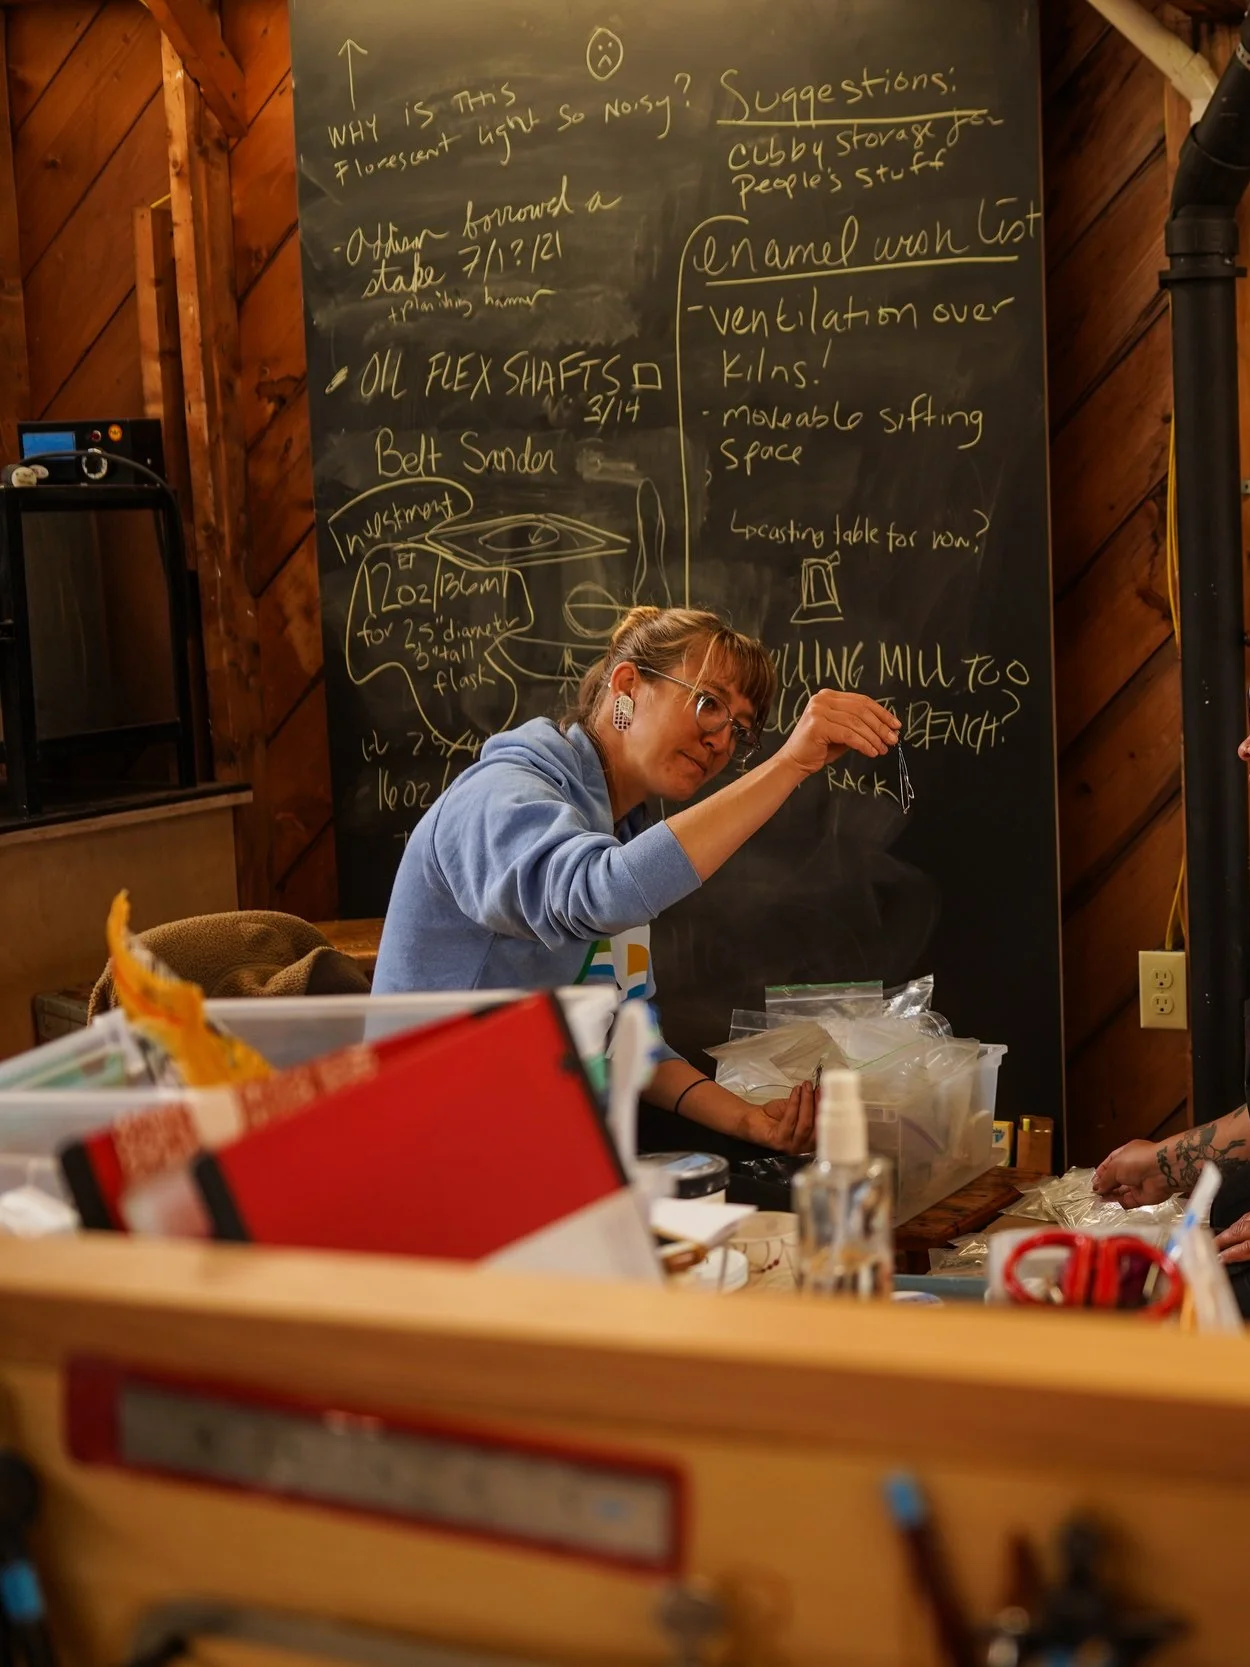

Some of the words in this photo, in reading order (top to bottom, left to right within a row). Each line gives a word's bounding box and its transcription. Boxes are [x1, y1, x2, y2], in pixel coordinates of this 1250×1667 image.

[719, 67, 957, 129] Suggestions:
[328, 114, 378, 149] WHY
[587, 190, 623, 211] a
[693, 214, 860, 276] enamel
[872, 220, 971, 264] wish
[931, 296, 1016, 324] over
[425, 351, 492, 401] FLEX
[503, 350, 622, 397] SHAFTS
[722, 400, 864, 431] moveable
[879, 392, 984, 450] sifting
[374, 427, 443, 477] Belt
[460, 431, 558, 475] Sander
[832, 513, 880, 546] table
[886, 521, 918, 553] for
[357, 612, 394, 648] for
[439, 639, 475, 665] tall
[768, 638, 864, 691] LLING
[878, 640, 956, 688] MILL
[432, 662, 496, 697] flask
[825, 764, 901, 804] RACK
